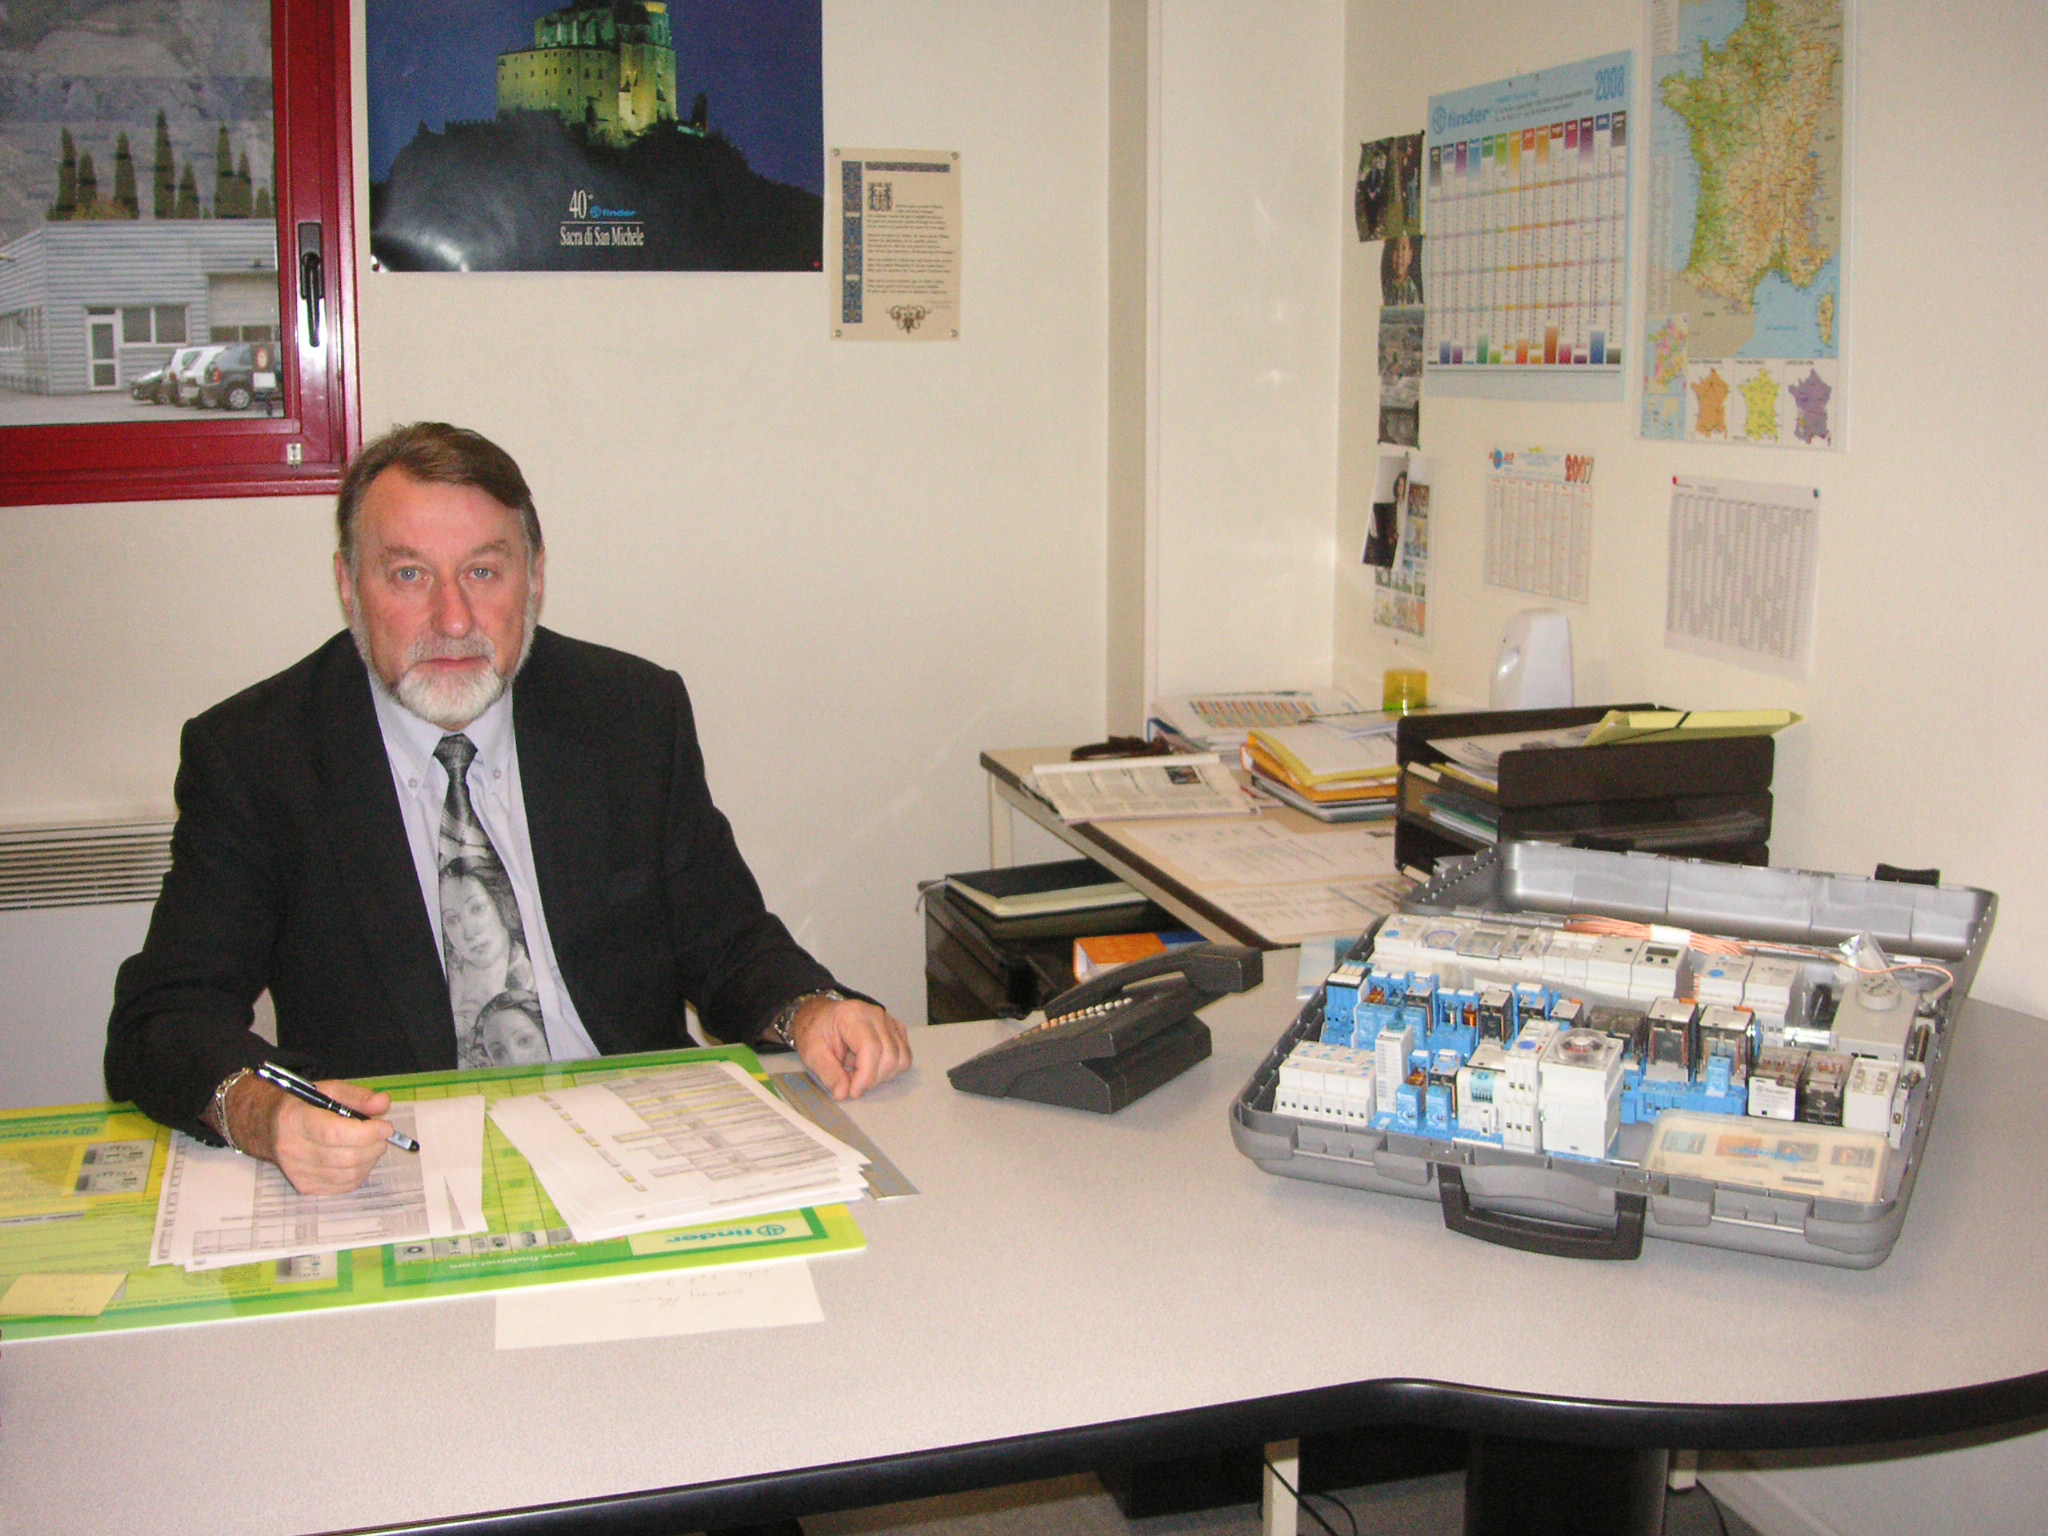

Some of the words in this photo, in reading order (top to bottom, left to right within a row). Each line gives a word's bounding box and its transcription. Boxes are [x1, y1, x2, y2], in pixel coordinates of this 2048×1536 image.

[560, 226, 582, 246] Sacra
[584, 226, 593, 246] di
[594, 226, 610, 246] San
[611, 226, 644, 246] Michele
[666, 1228, 753, 1243] finder
